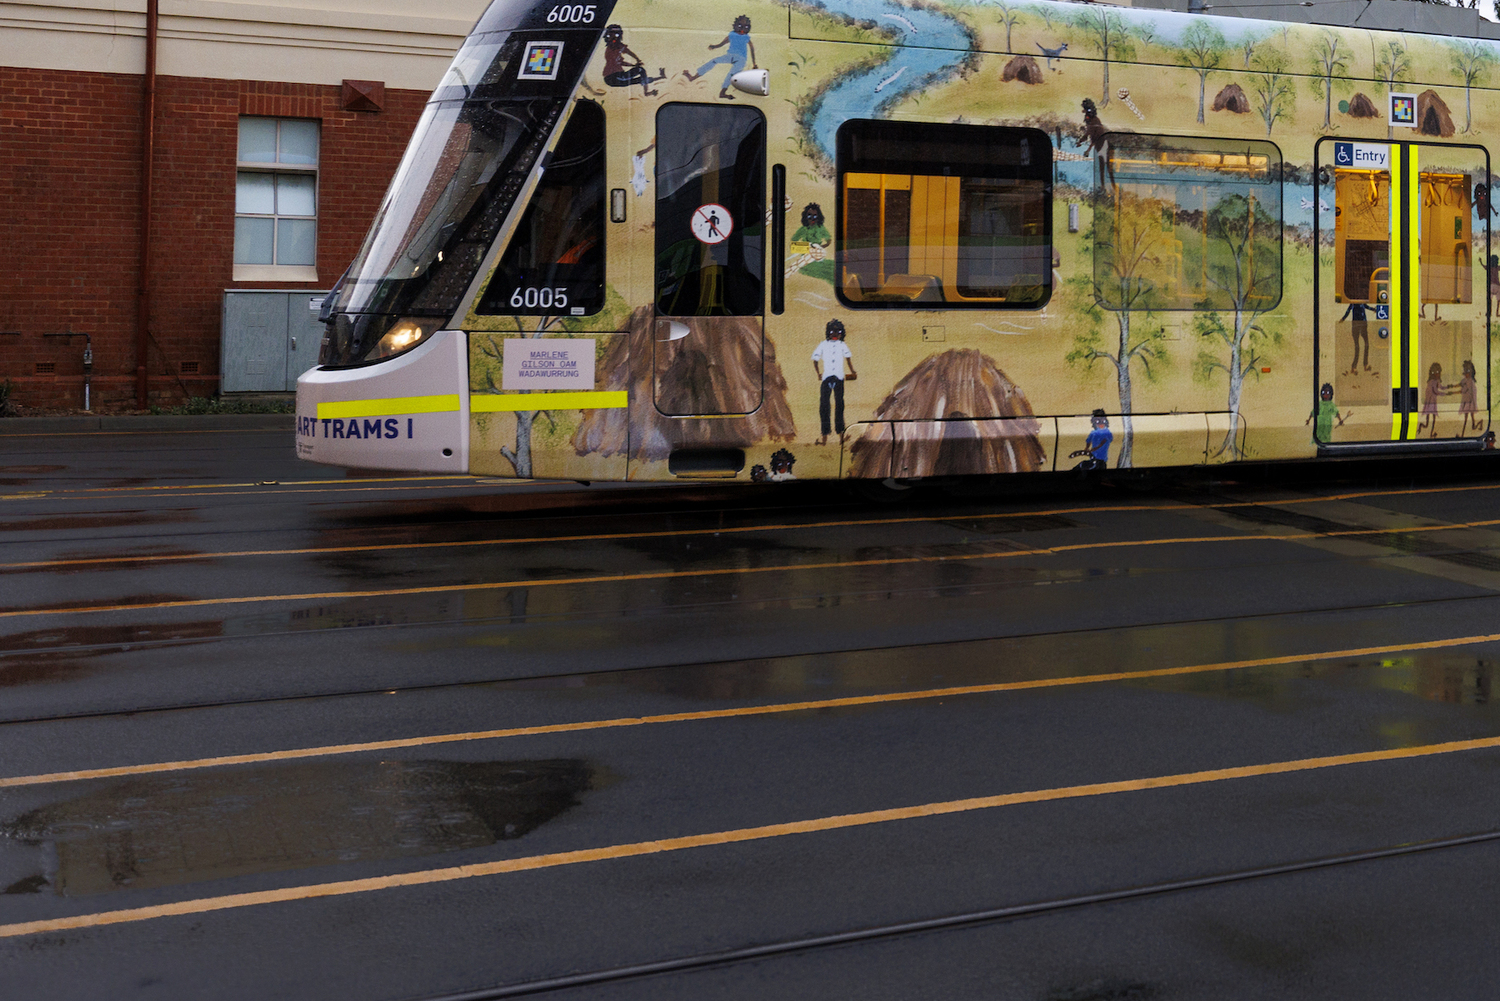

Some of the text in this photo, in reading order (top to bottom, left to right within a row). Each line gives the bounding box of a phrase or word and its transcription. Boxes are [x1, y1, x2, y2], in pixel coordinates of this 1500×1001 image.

[547, 5, 597, 23] 6005
[1355, 149, 1386, 164] Entry
[510, 287, 568, 308] 6005
[530, 351, 569, 359] MARLENE
[521, 360, 577, 368] GILSON OAM
[518, 370, 579, 378] WADAWURRUNG
[298, 416, 317, 437] ART
[322, 418, 399, 439] TRAMS
